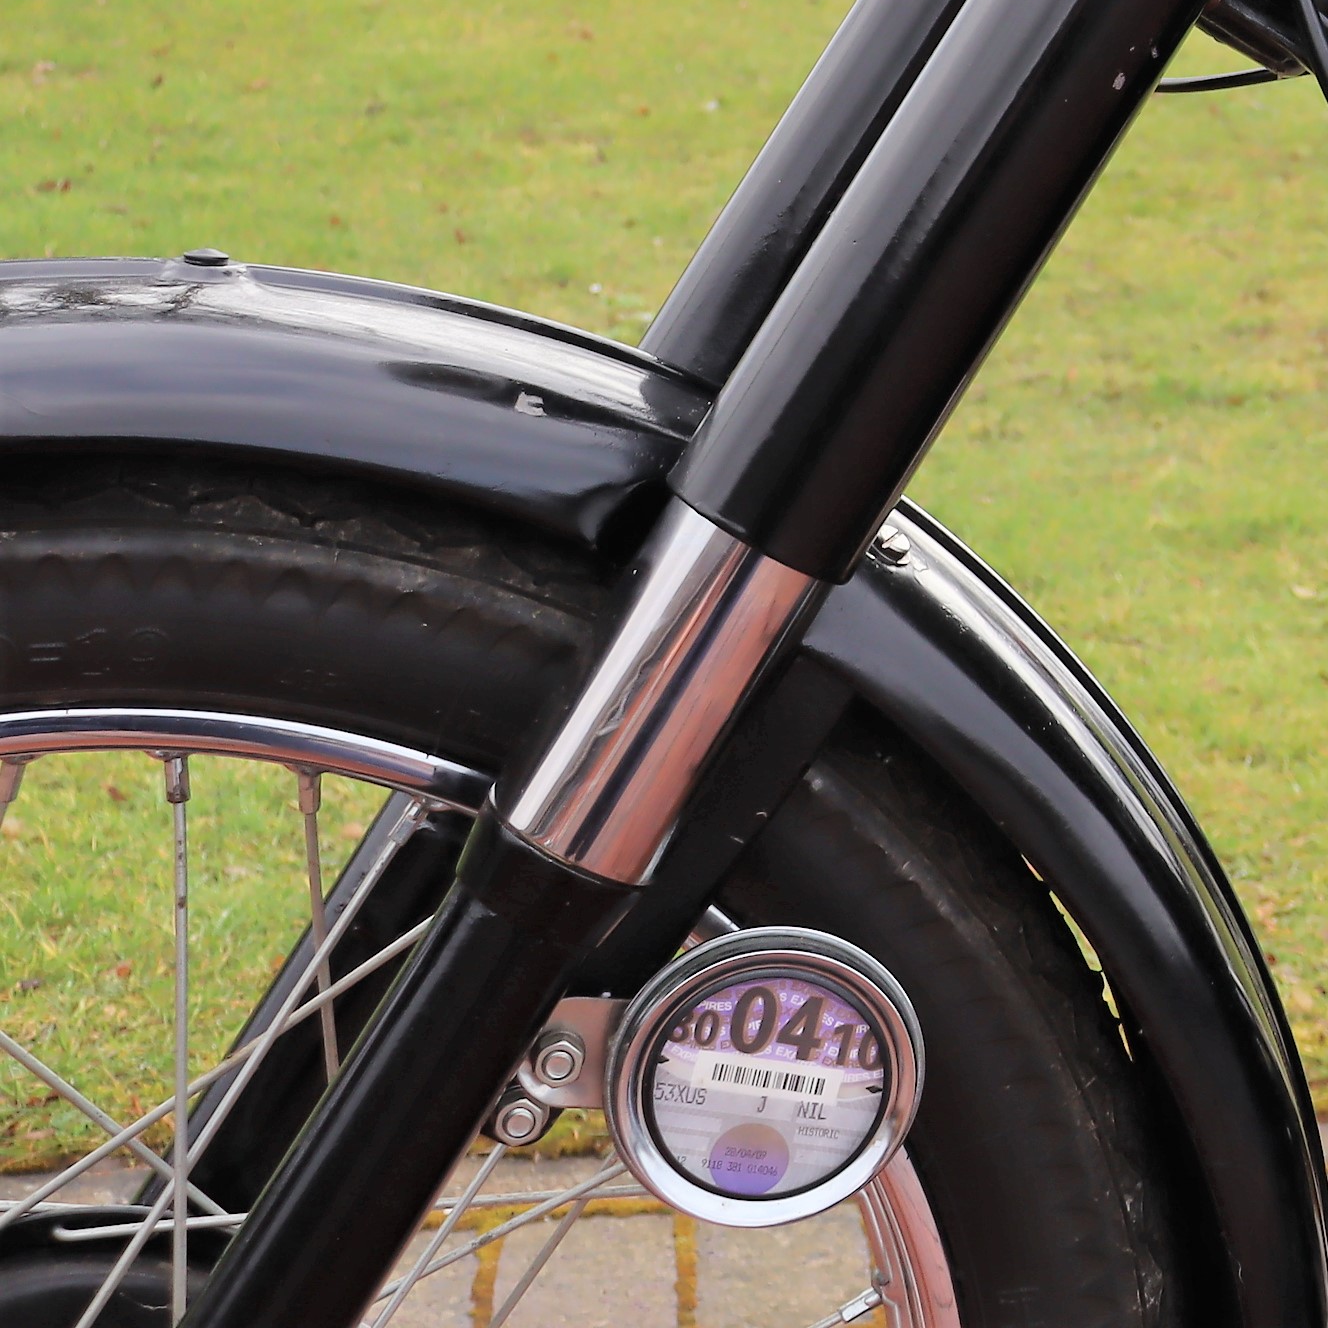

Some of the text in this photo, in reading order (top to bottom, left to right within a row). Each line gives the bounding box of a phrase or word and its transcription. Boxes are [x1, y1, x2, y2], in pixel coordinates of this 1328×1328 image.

[730, 985, 827, 1060] 04
[756, 1095, 769, 1113] J
[796, 1100, 828, 1120] NIL
[797, 1126, 840, 1140] HISTORIC
